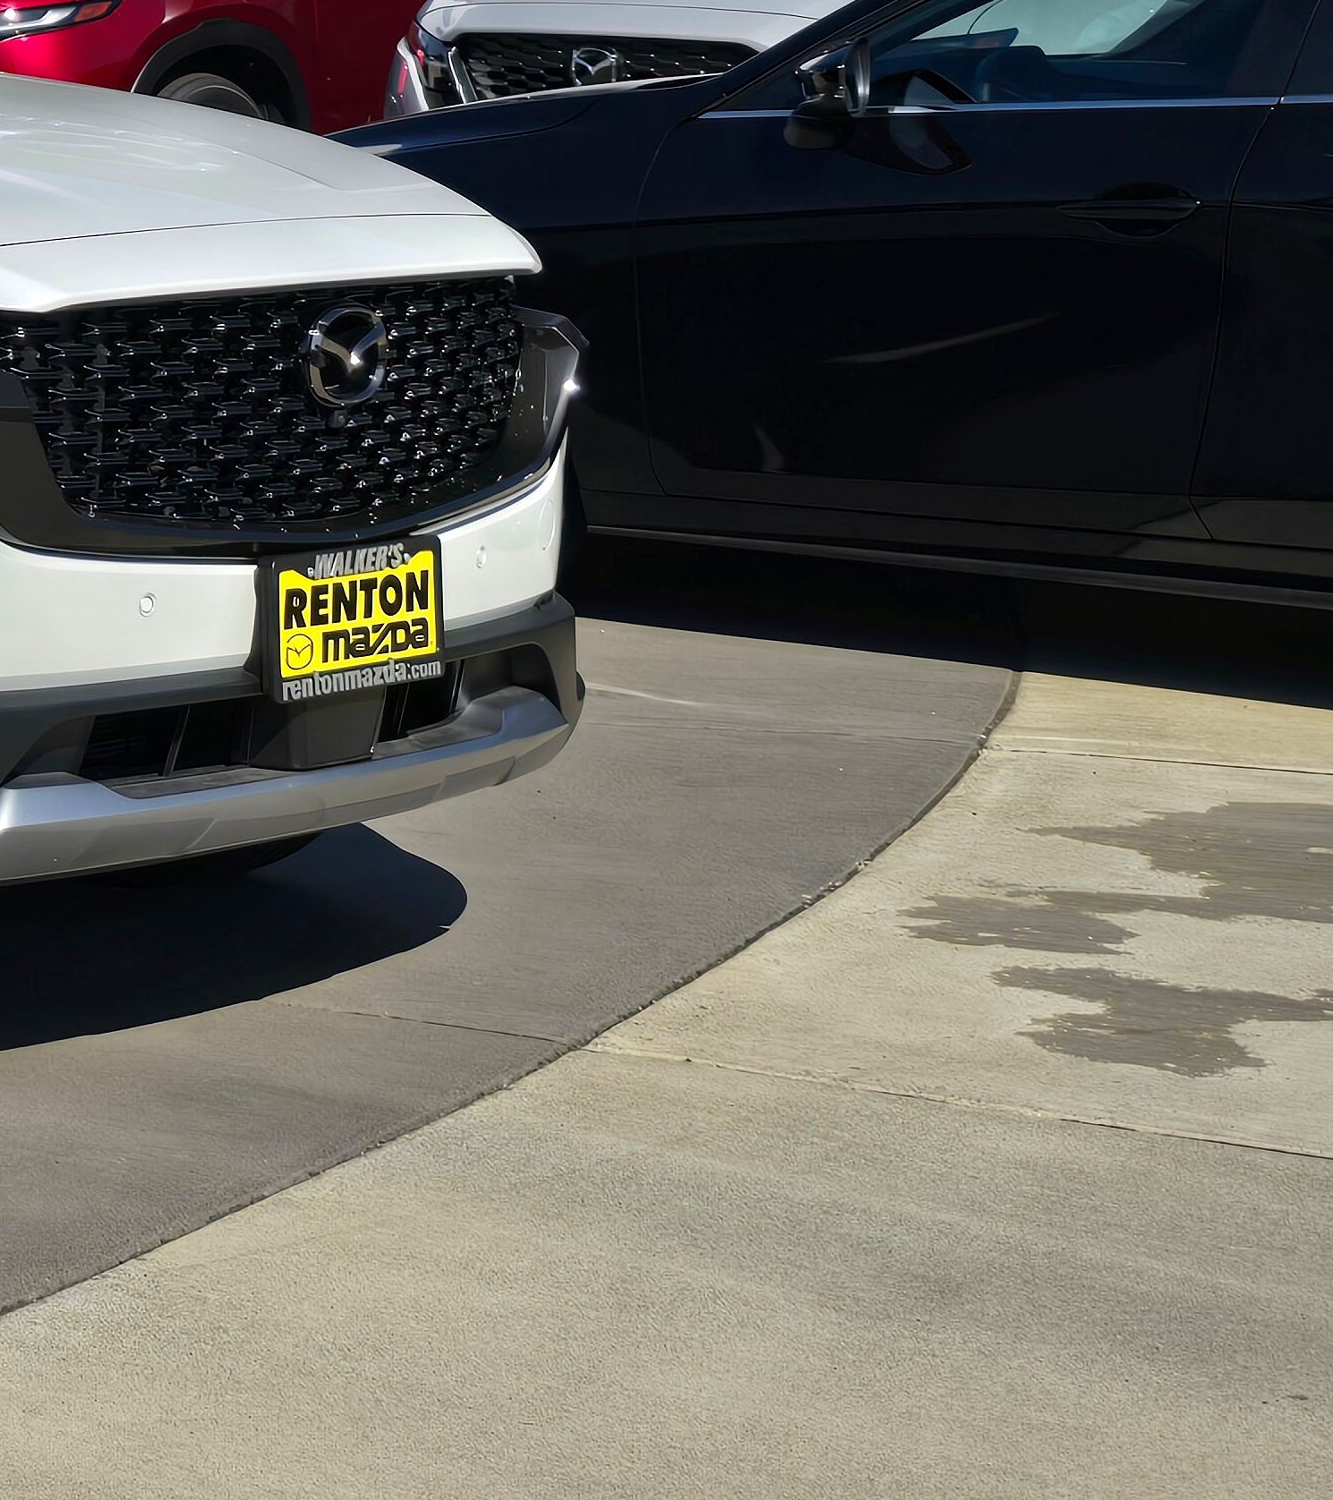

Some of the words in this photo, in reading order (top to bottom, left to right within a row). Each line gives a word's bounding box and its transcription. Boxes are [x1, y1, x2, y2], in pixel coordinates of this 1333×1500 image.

[314, 542, 404, 580] WALKER'S
[283, 569, 429, 630] RENTON
[282, 658, 442, 701] rentonmazda.com
